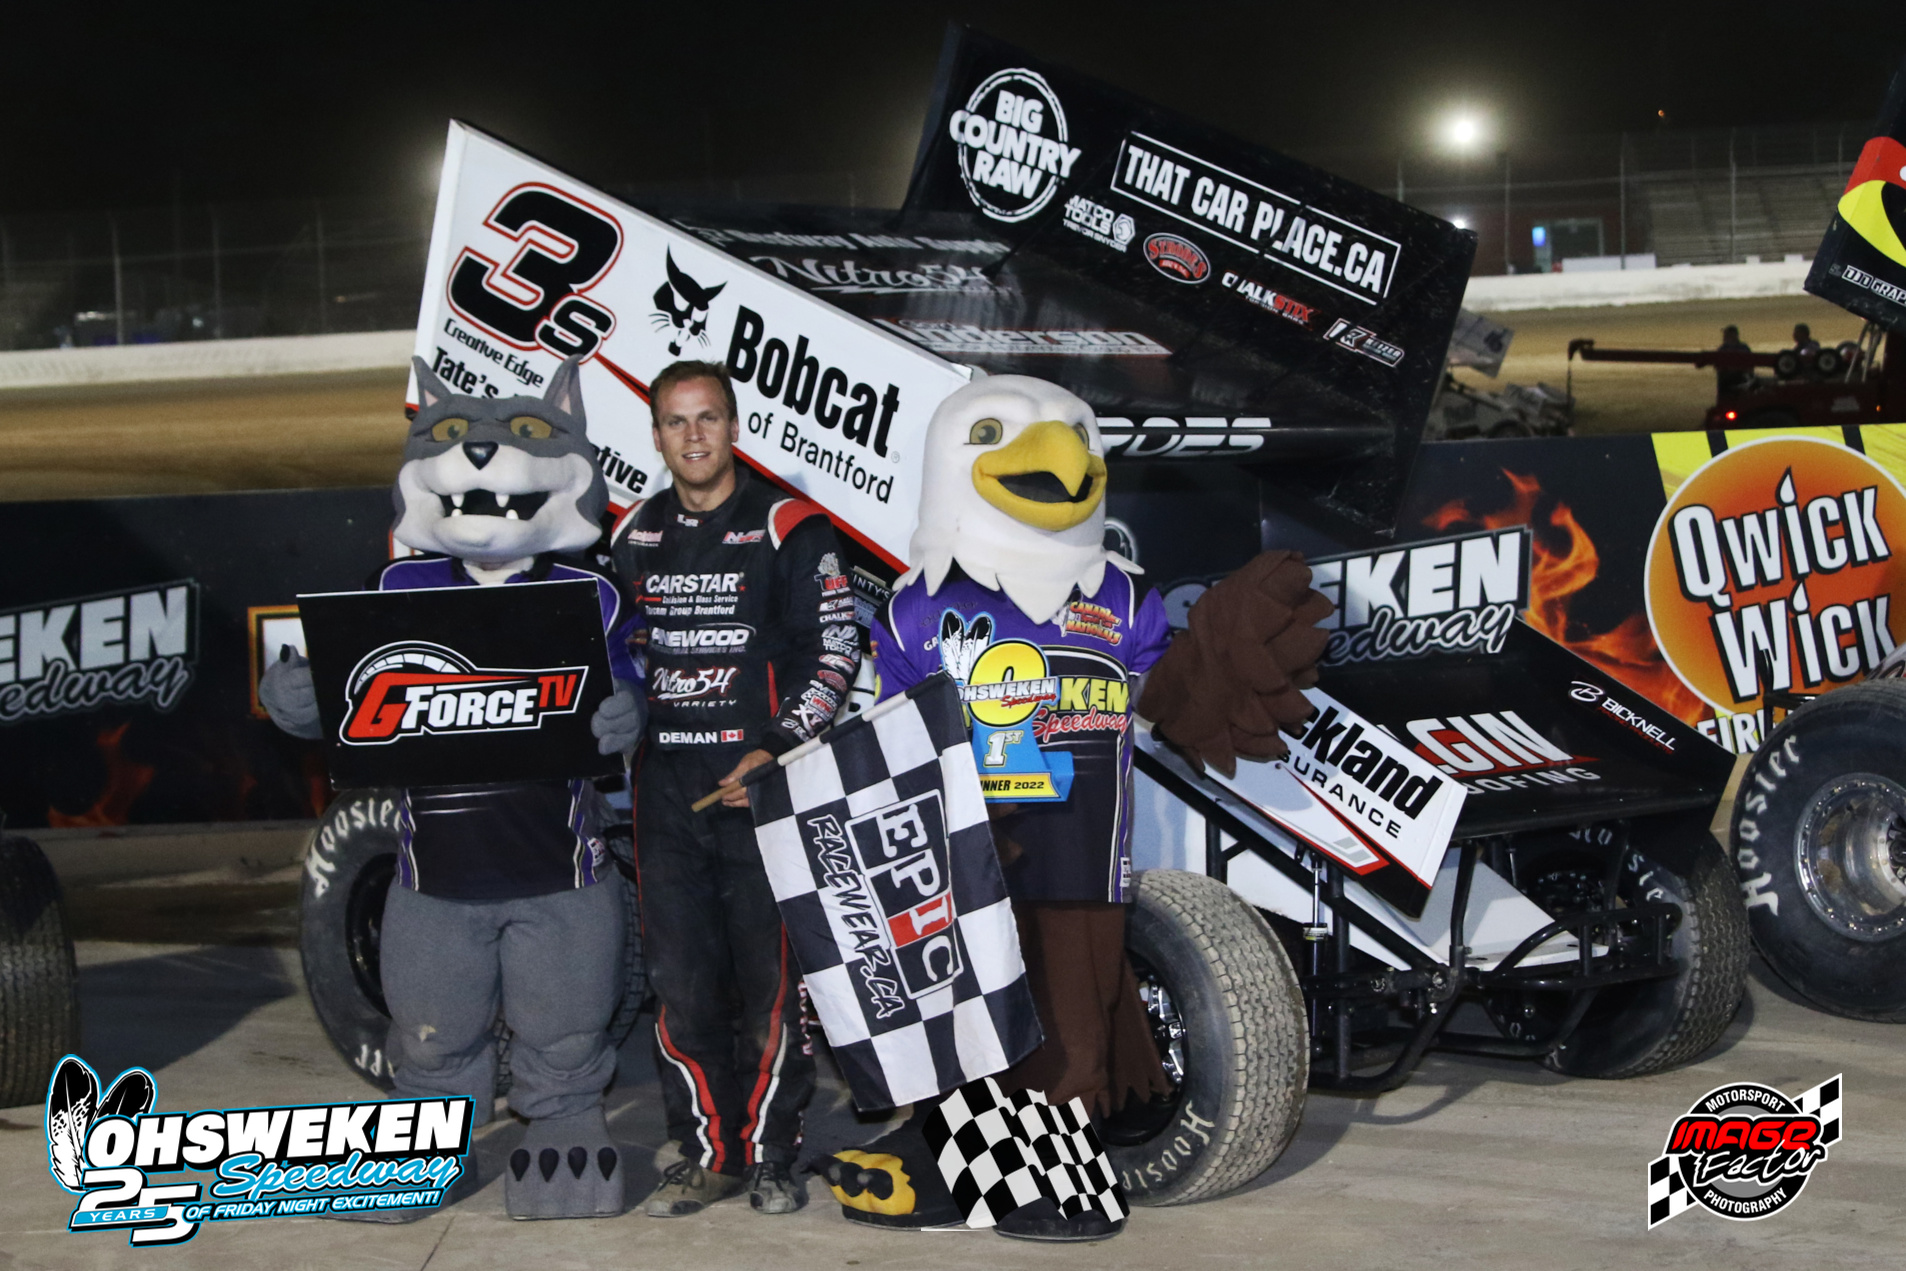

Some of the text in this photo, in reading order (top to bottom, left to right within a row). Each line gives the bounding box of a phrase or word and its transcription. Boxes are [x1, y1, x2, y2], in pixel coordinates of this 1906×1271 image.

[995, 89, 1044, 134] BIG
[949, 109, 1082, 178] COUNTRY
[973, 150, 1043, 199] RAW
[1064, 203, 1112, 236] TOOLS
[1124, 145, 1386, 294] THAT CAR PLACE.CA
[433, 346, 499, 399] Tate's
[444, 318, 544, 388] Creative Edge
[726, 305, 899, 458] Bobcat
[593, 444, 648, 494] tive
[748, 411, 894, 503] of Brantford
[646, 573, 740, 594] CARSTAR
[714, 594, 738, 603] Service
[669, 605, 693, 617] Group
[694, 604, 735, 616] Brantford
[652, 667, 738, 694] Nitro54
[673, 699, 737, 708] VARIETY
[1001, 694, 1057, 709] Speedway
[1048, 677, 1130, 713] KEN
[659, 731, 717, 744] DEMAN
[1400, 711, 1574, 773] GIN
[1602, 696, 1676, 751] BICKNELL
[1014, 782, 1044, 790] 2022
[807, 814, 905, 1019] RACEWEAR.CA
[875, 803, 952, 982] EPIC
